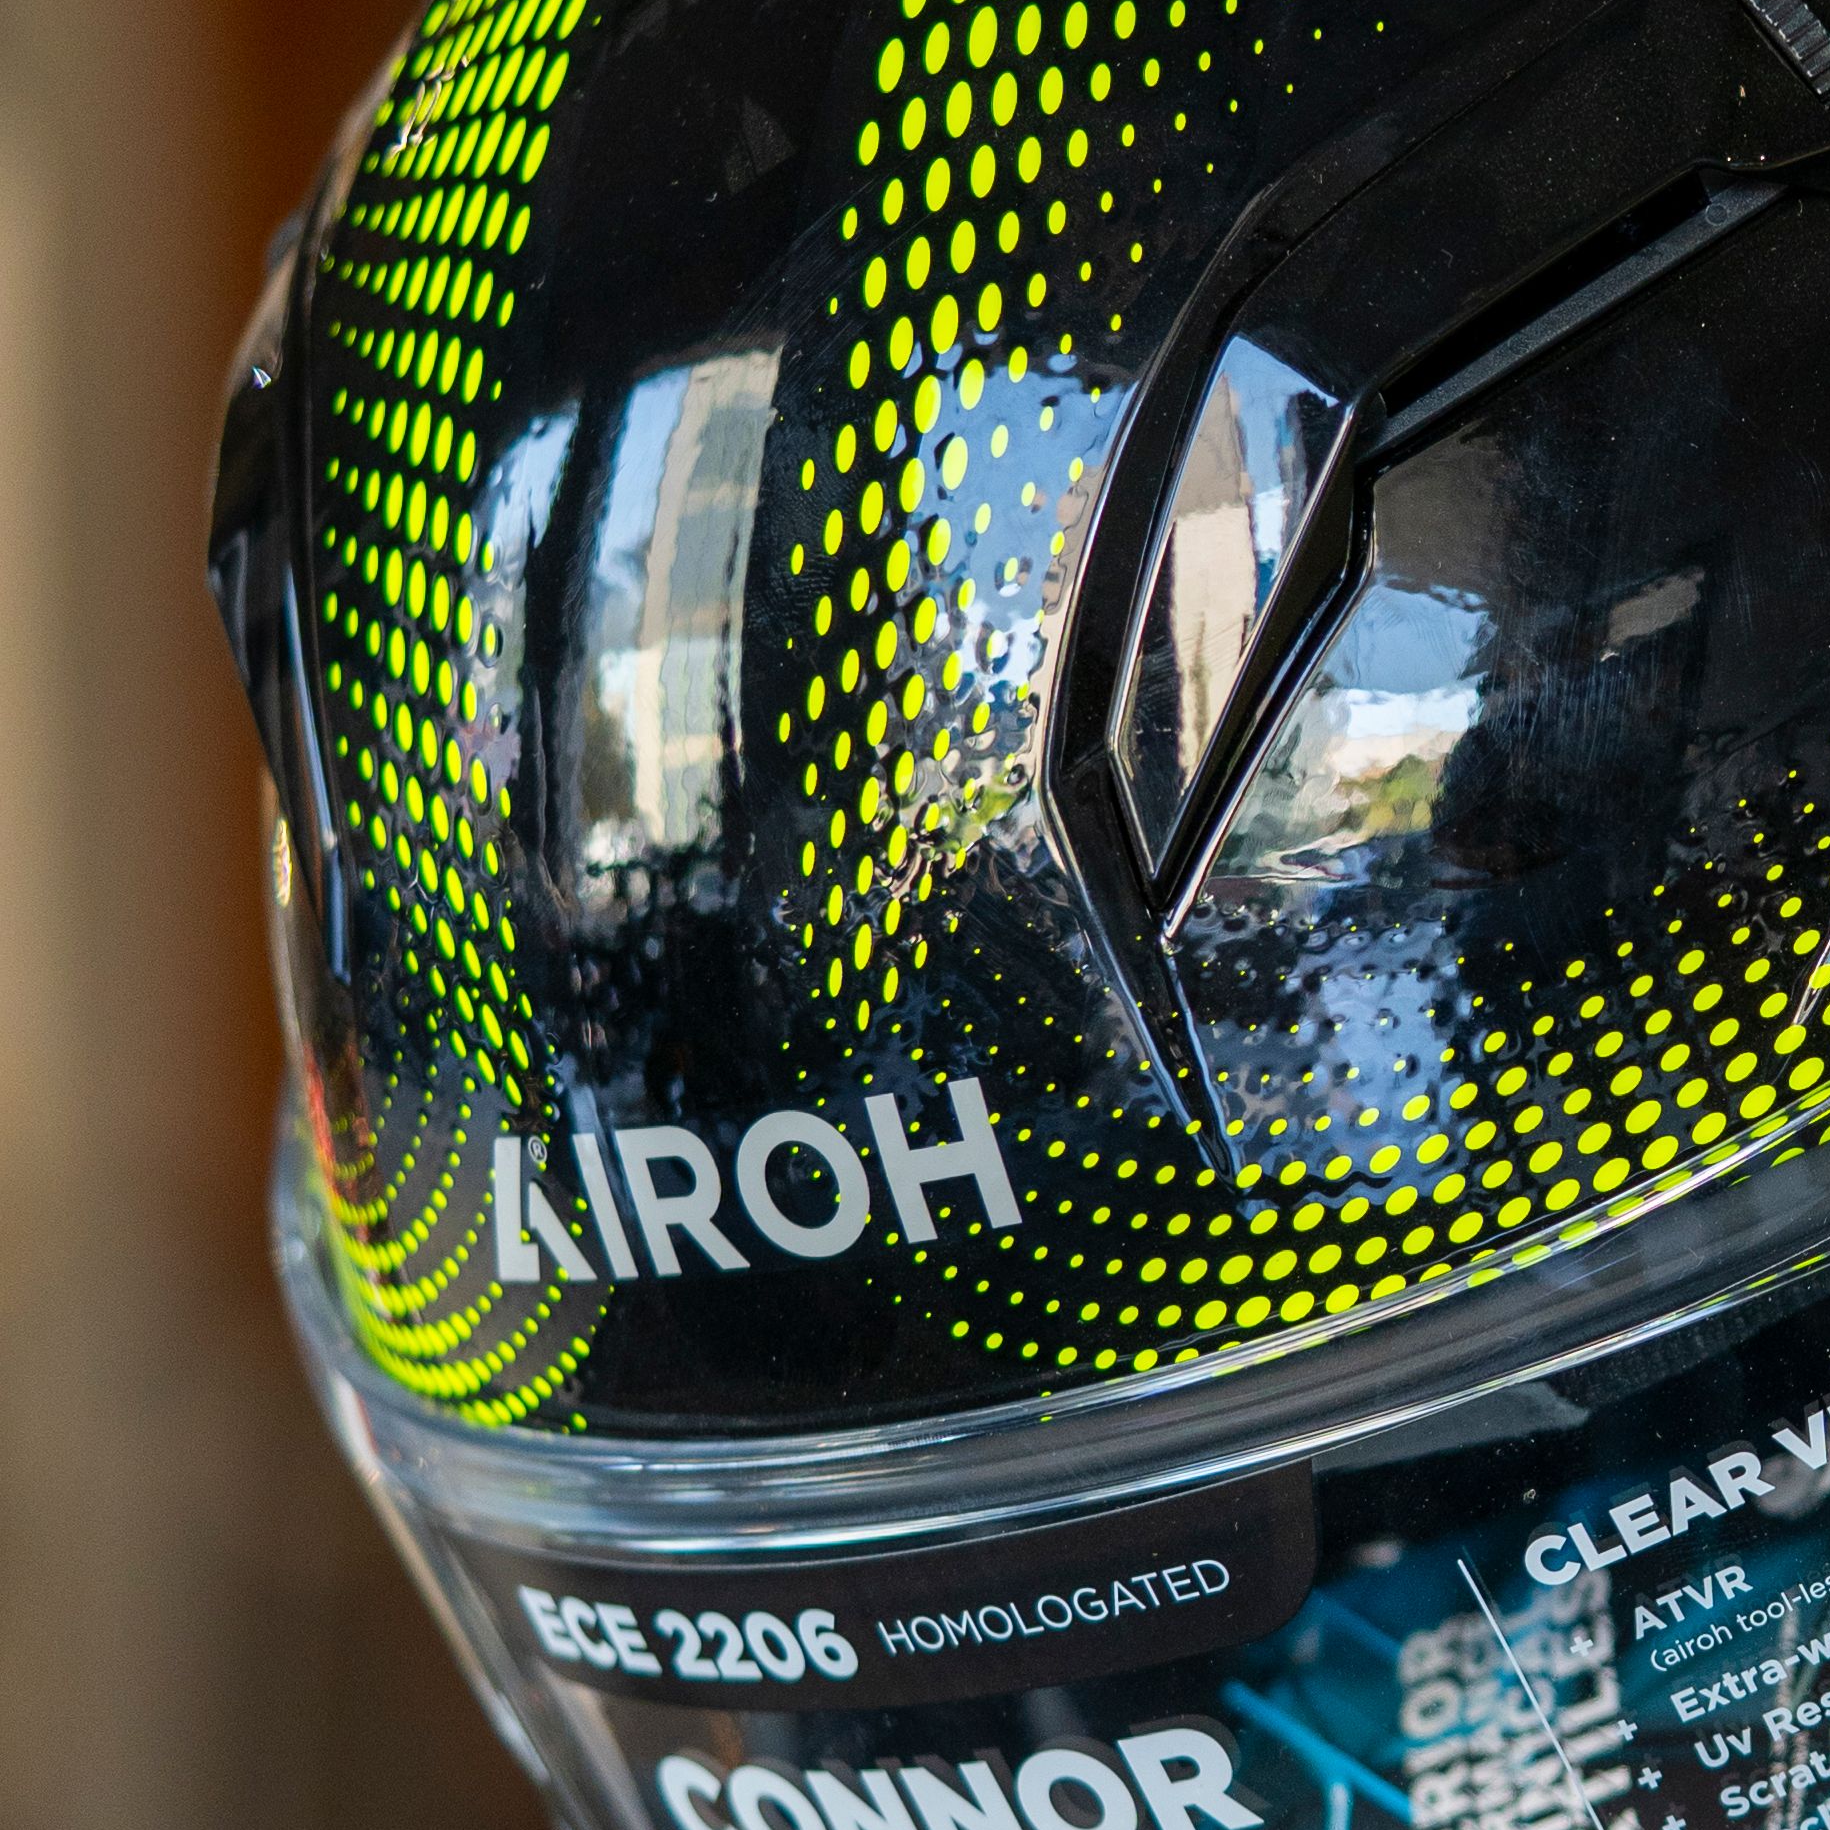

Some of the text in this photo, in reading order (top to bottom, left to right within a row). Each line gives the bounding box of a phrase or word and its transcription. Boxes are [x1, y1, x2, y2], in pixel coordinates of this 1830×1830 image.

[494, 1077, 1023, 1281] AIROH
[1525, 1450, 1774, 1586] CLEAR
[518, 1559, 1230, 1683] ECE 2206 HOMOLOGATED
[1632, 1564, 1753, 1639] ATVR
[1650, 1622, 1733, 1671] (airoh
[1693, 1724, 1754, 1771] Uv
